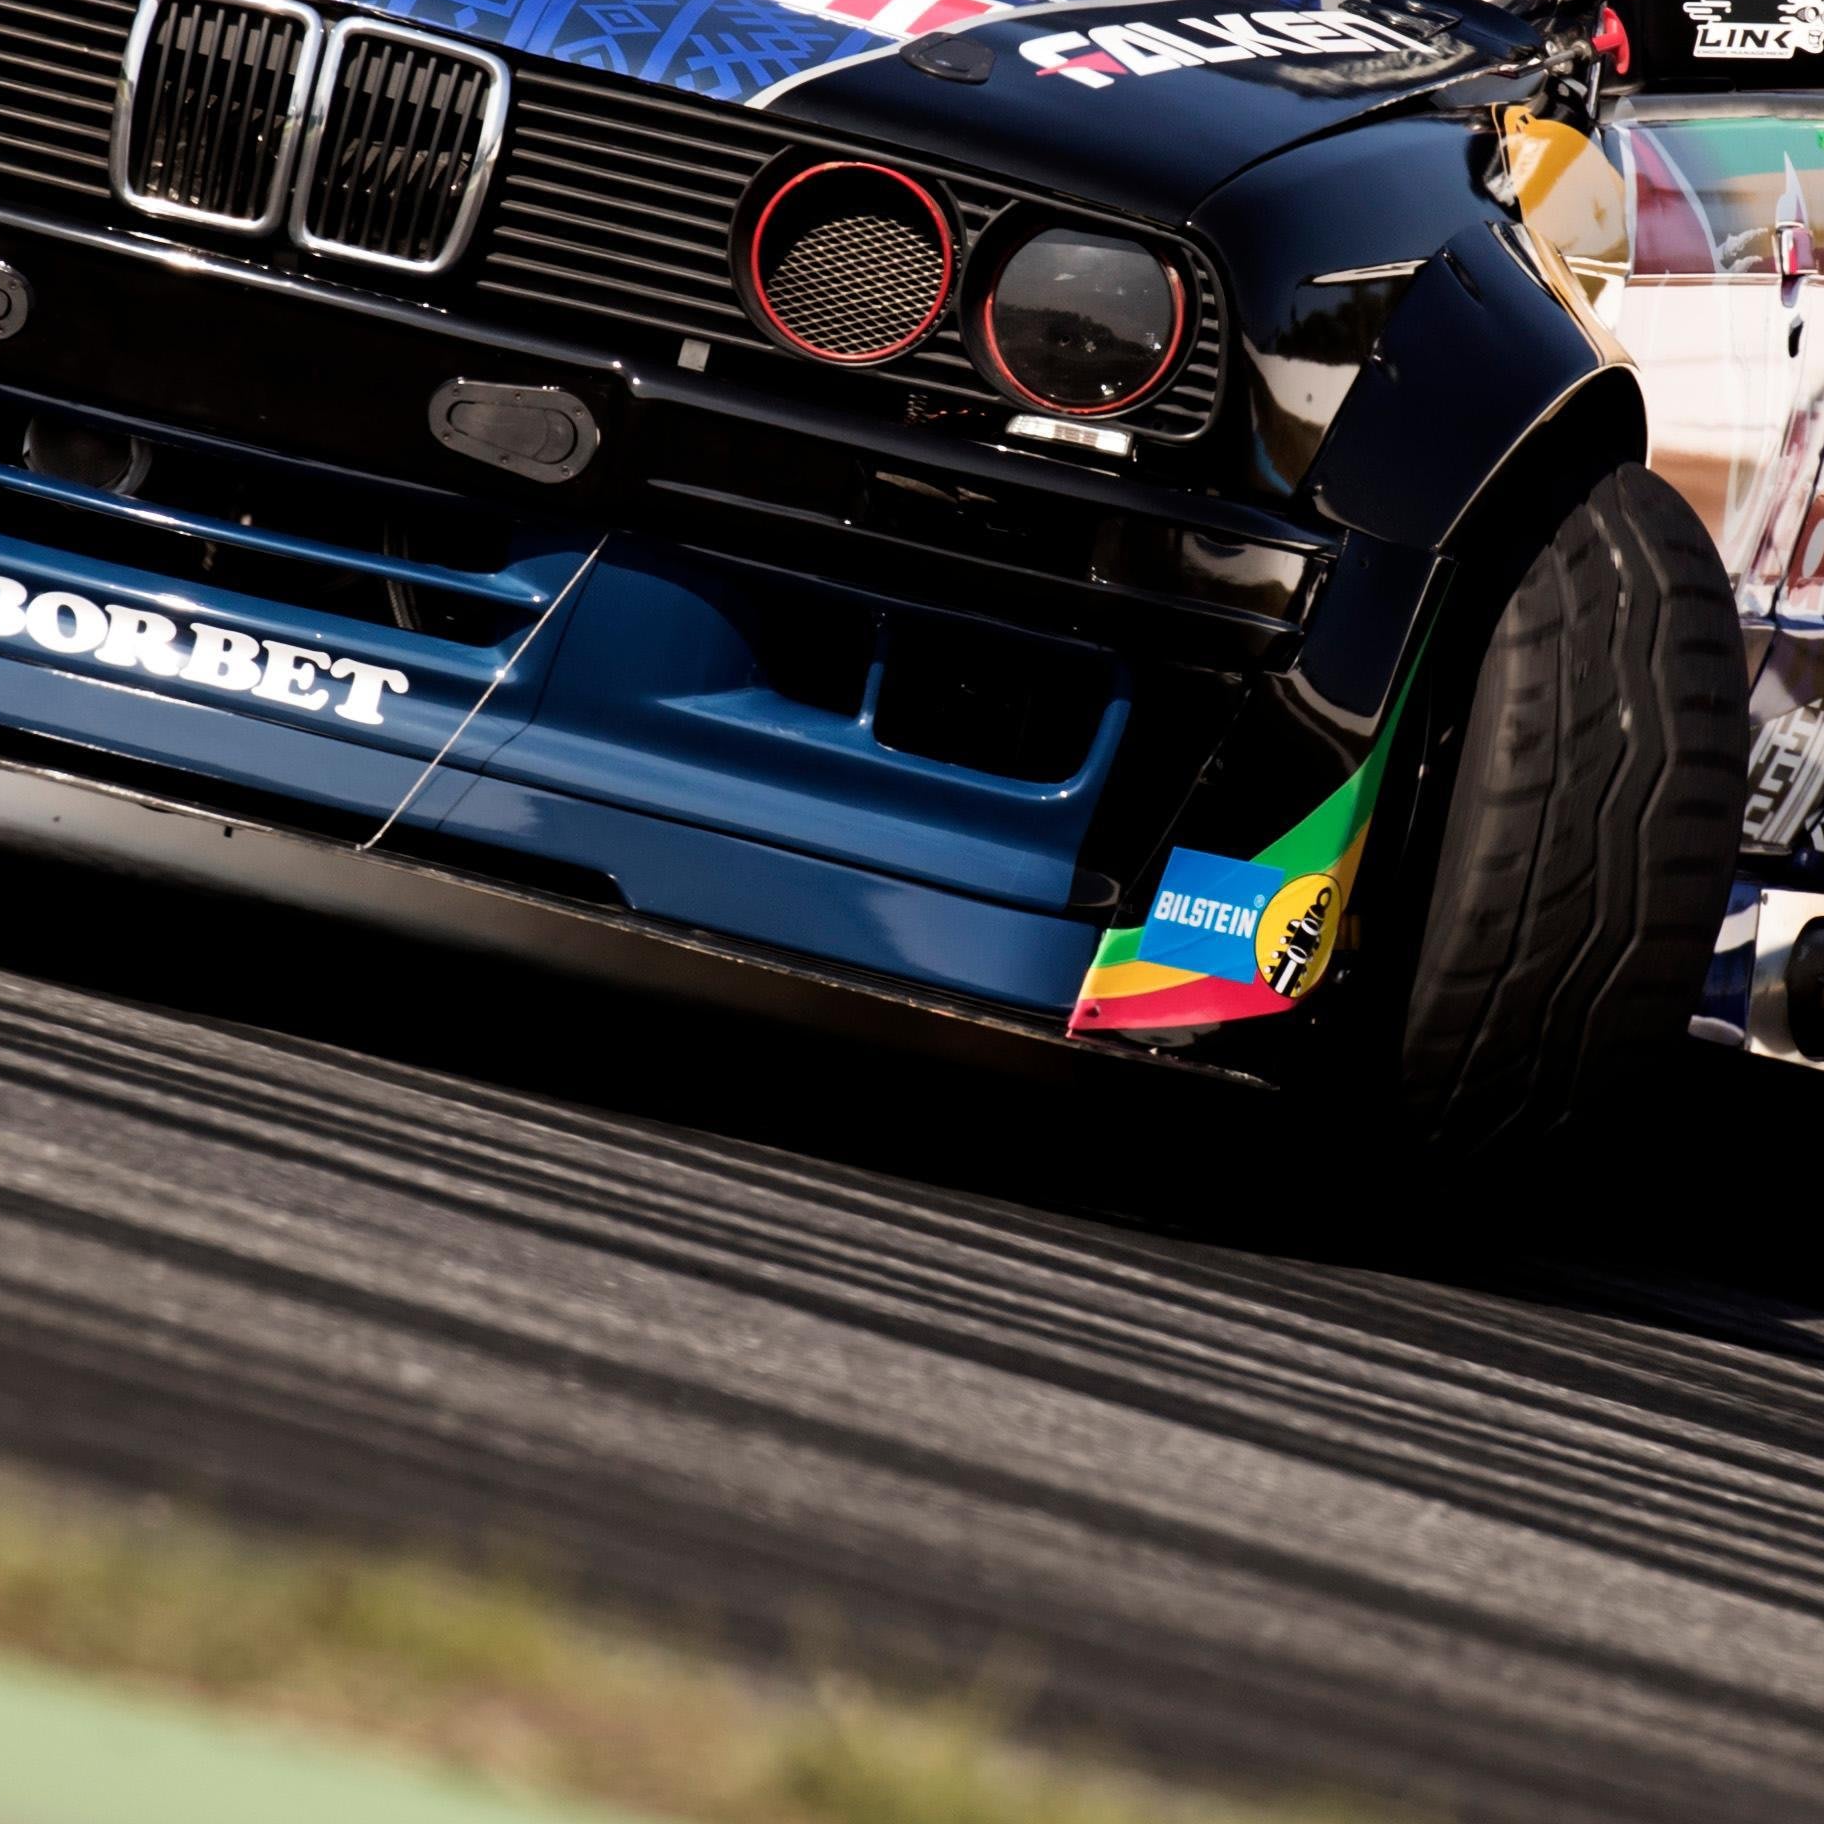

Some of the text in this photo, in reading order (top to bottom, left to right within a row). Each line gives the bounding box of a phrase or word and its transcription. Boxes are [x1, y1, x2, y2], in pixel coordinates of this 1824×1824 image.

[1018, 10, 1438, 89] FALKEN
[1699, 28, 1793, 49] LINK
[1154, 889, 1258, 940] BILSTEIN
